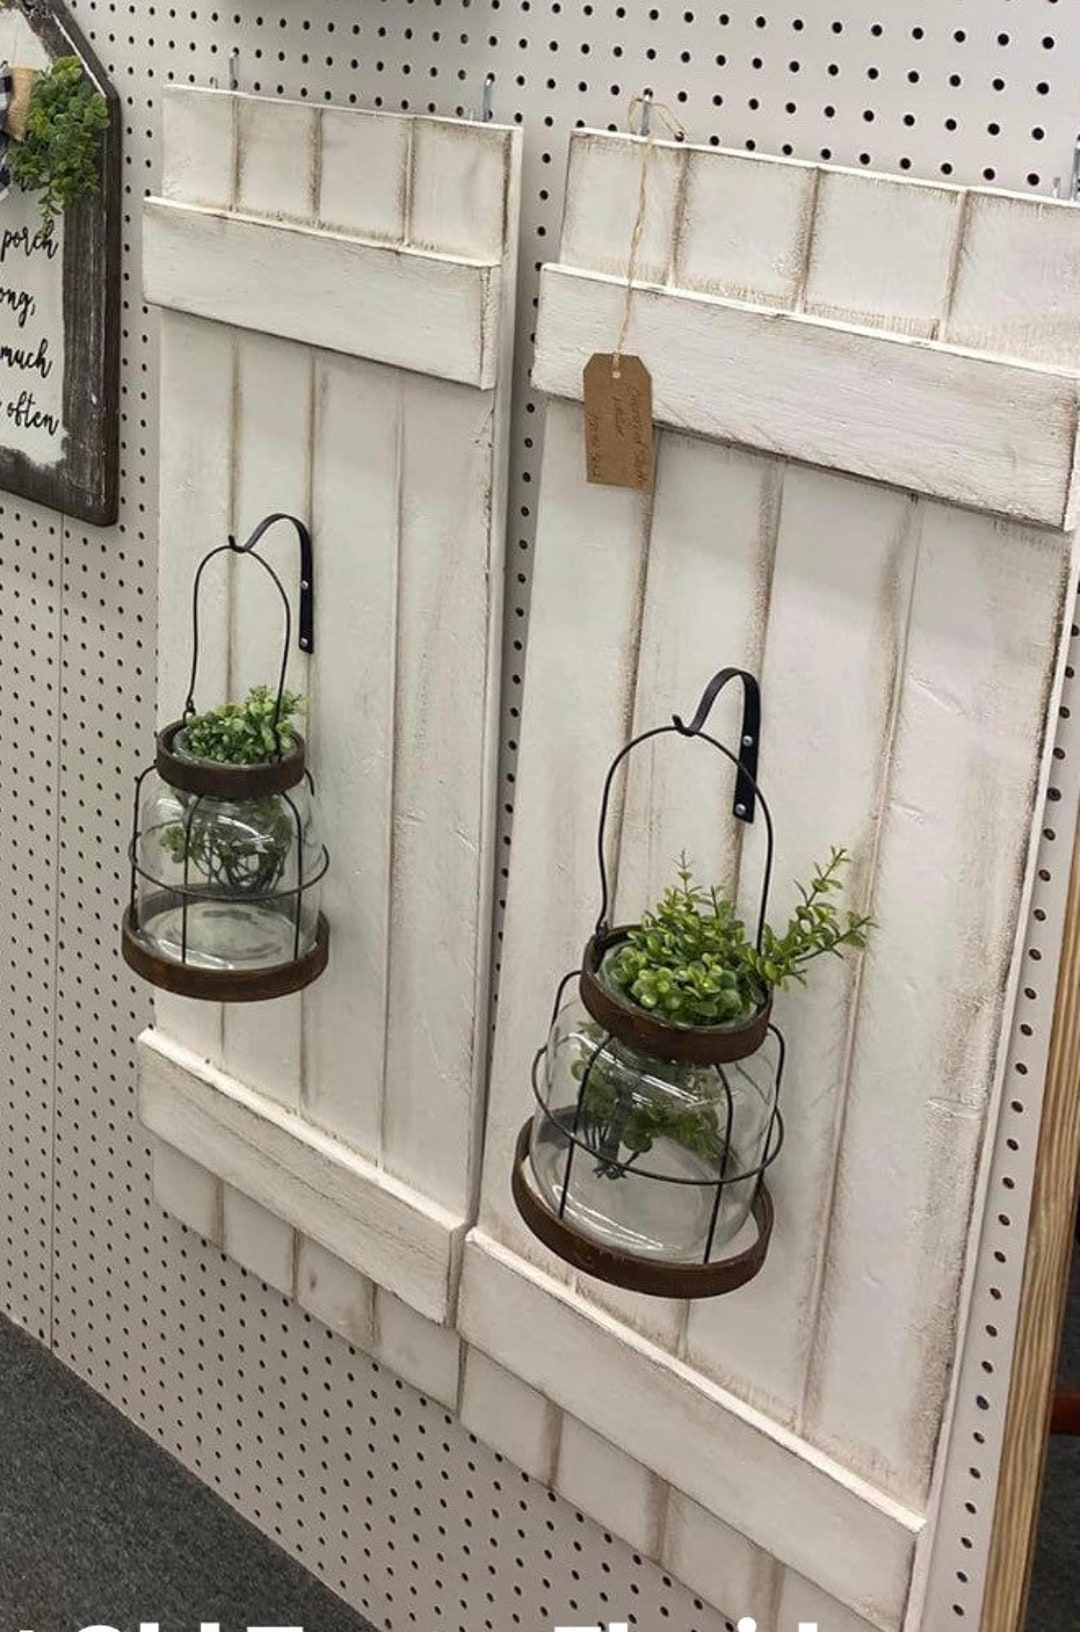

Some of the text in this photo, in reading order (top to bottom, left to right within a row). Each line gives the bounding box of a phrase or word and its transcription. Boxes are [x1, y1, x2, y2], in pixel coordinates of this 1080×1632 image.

[0, 218, 59, 262] porch
[0, 338, 53, 378] much
[6, 390, 60, 436] often
